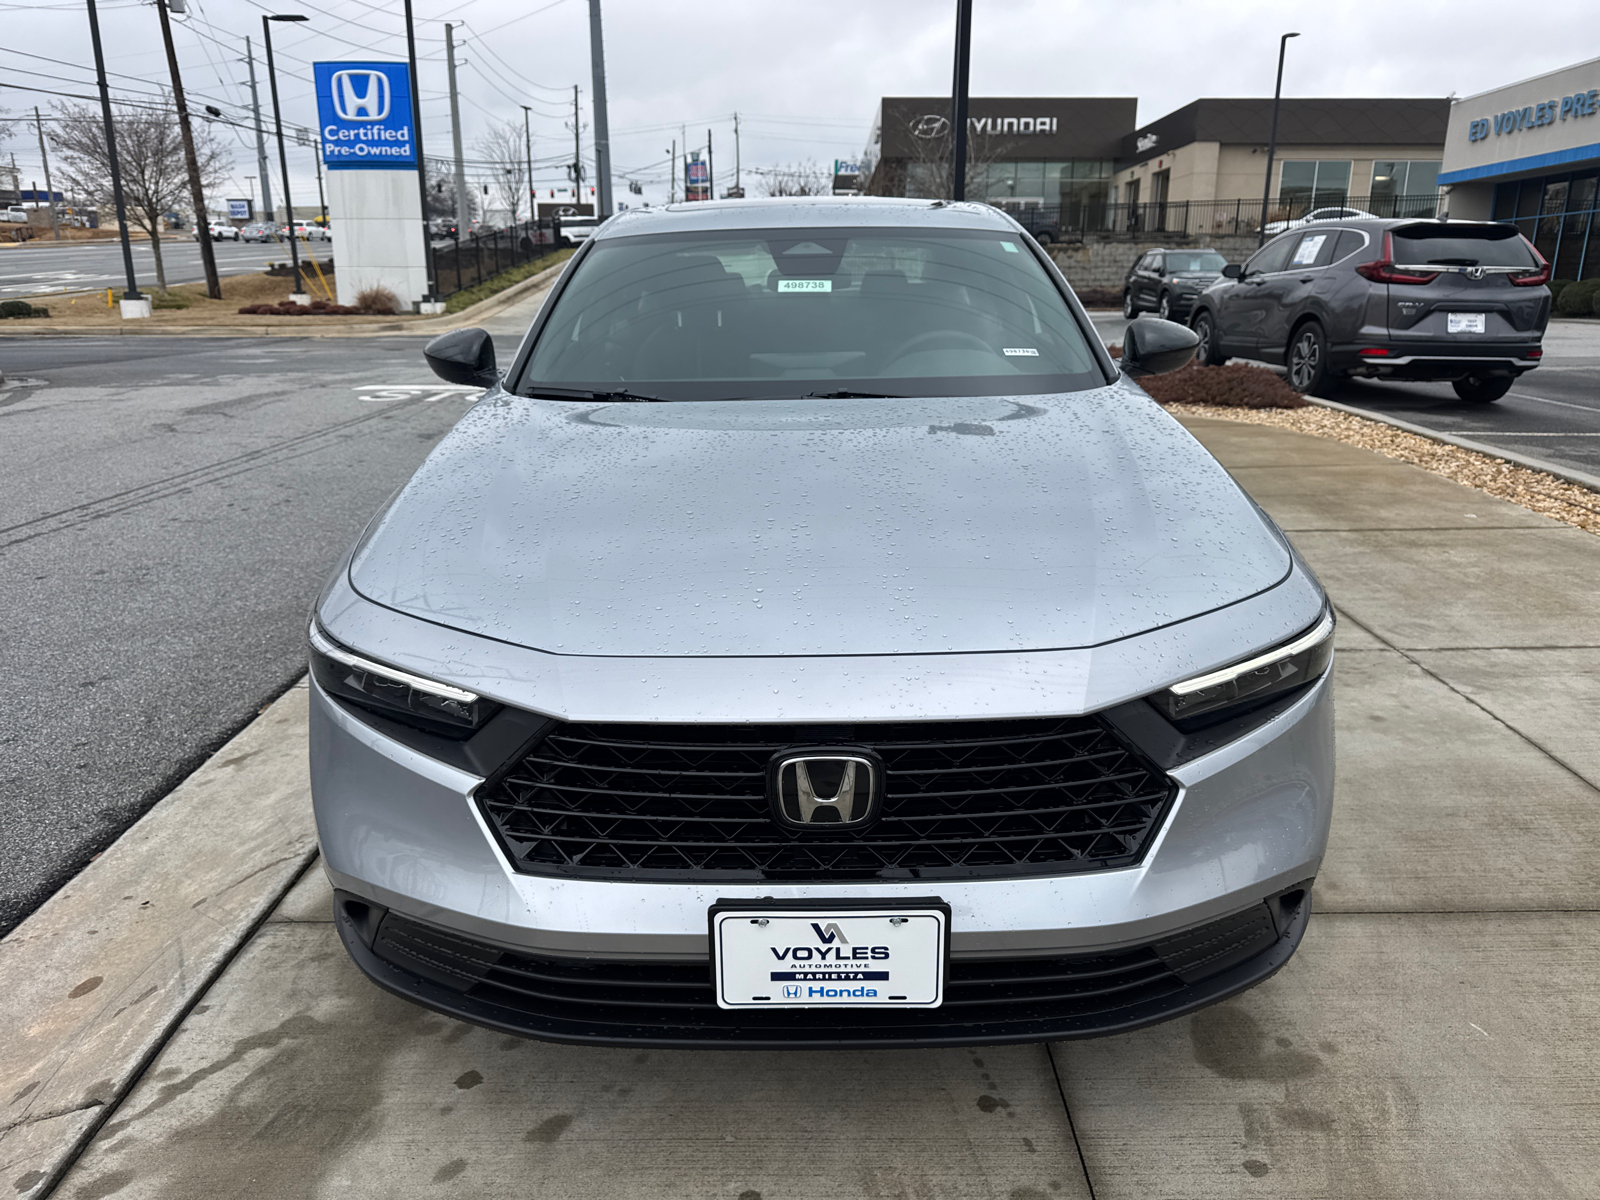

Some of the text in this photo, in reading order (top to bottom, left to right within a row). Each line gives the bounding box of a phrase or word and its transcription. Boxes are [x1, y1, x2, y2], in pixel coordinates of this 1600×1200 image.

[967, 117, 1058, 135] YUNDAI
[1468, 118, 1488, 141] ED
[1494, 100, 1557, 135] VOYLES
[324, 125, 409, 141] Certified
[325, 143, 411, 156] Pre-Owned
[783, 281, 825, 289] 498738
[770, 946, 890, 961] VOYLES
[808, 986, 878, 997] Honda
